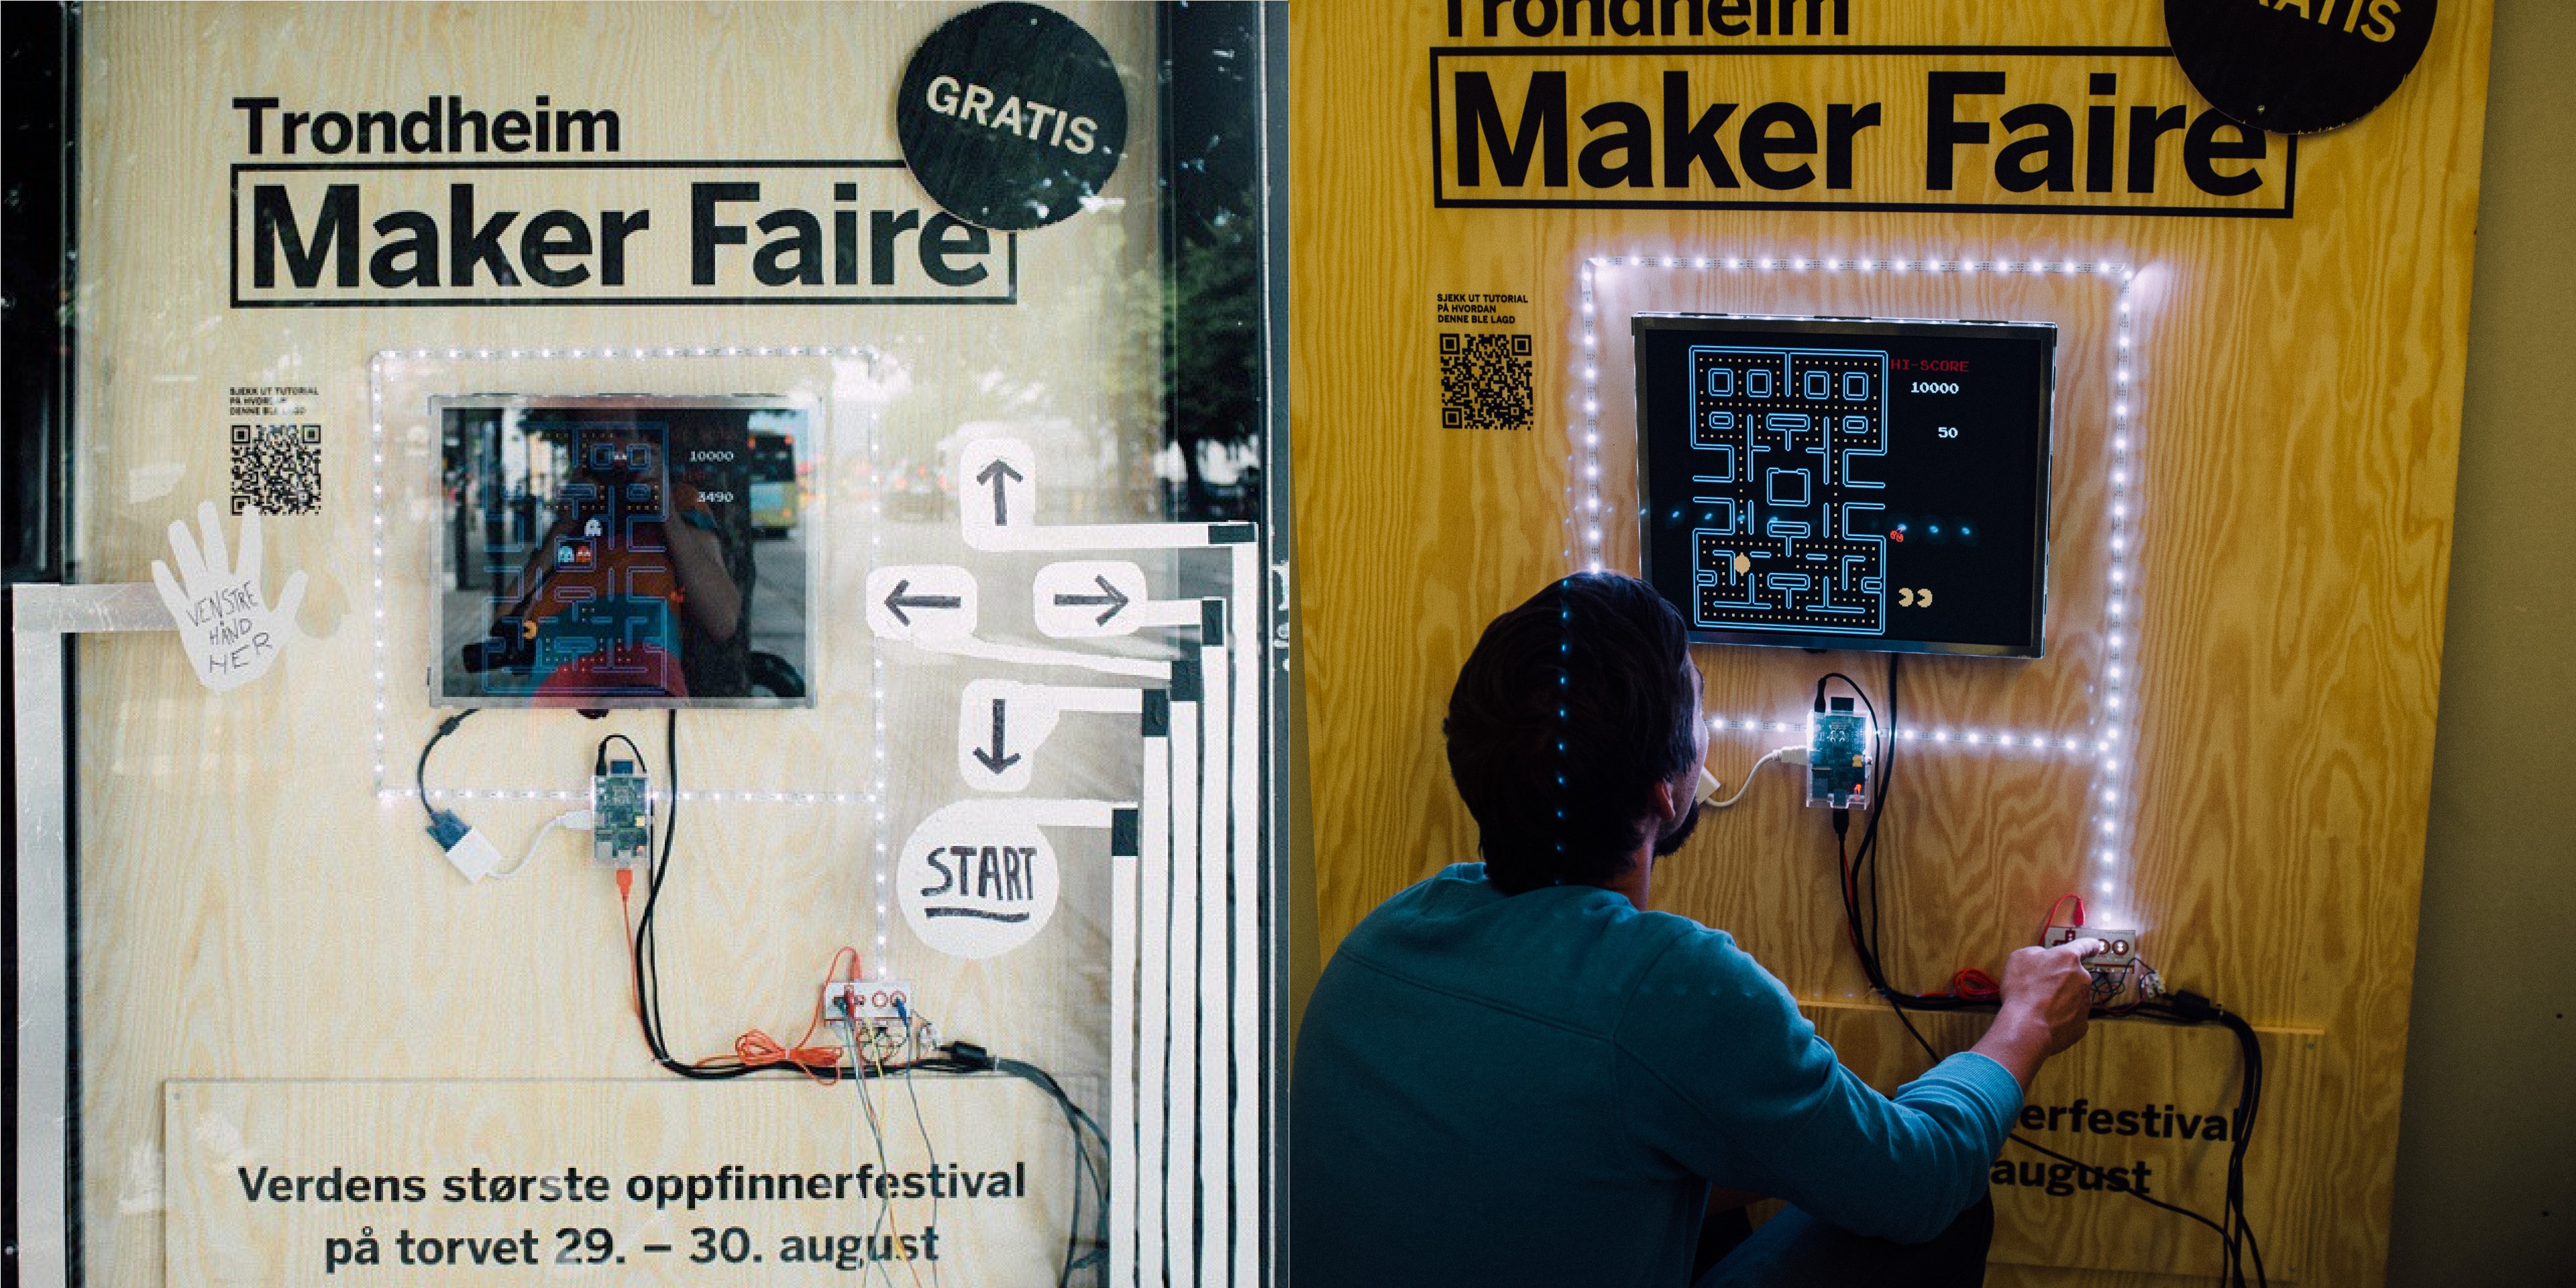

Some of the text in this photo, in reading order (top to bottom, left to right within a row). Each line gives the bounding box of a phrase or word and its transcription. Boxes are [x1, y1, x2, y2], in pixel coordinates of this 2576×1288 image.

[231, 95, 621, 154] Trondheim
[926, 74, 1099, 155] GRATIS
[1454, 70, 2267, 197] Maker Faire
[253, 181, 991, 289] Maker Faire
[1437, 293, 1528, 303] SJEKK UT TUTORIAL
[1437, 303, 1497, 313] PÅ HVORDAN
[1438, 314, 1516, 324] DENNE BLE LAGD
[1890, 359, 1970, 372] HI-SCORE
[1911, 382, 1960, 394] 10000
[1938, 427, 1959, 439] 50
[689, 451, 734, 462] 10000
[696, 491, 734, 502] 3490
[186, 580, 259, 627] VENSTRE
[209, 618, 253, 645] HÅND
[209, 632, 273, 675] HER
[921, 845, 1038, 902] START
[237, 1162, 1025, 1210] Verdens største oppfinnerfestival
[1990, 1158, 2153, 1197] august
[325, 1226, 380, 1273] på
[396, 1228, 539, 1265] torvet
[555, 1227, 626, 1265] 29.
[689, 1226, 763, 1264] 30.
[779, 1226, 939, 1271] august
